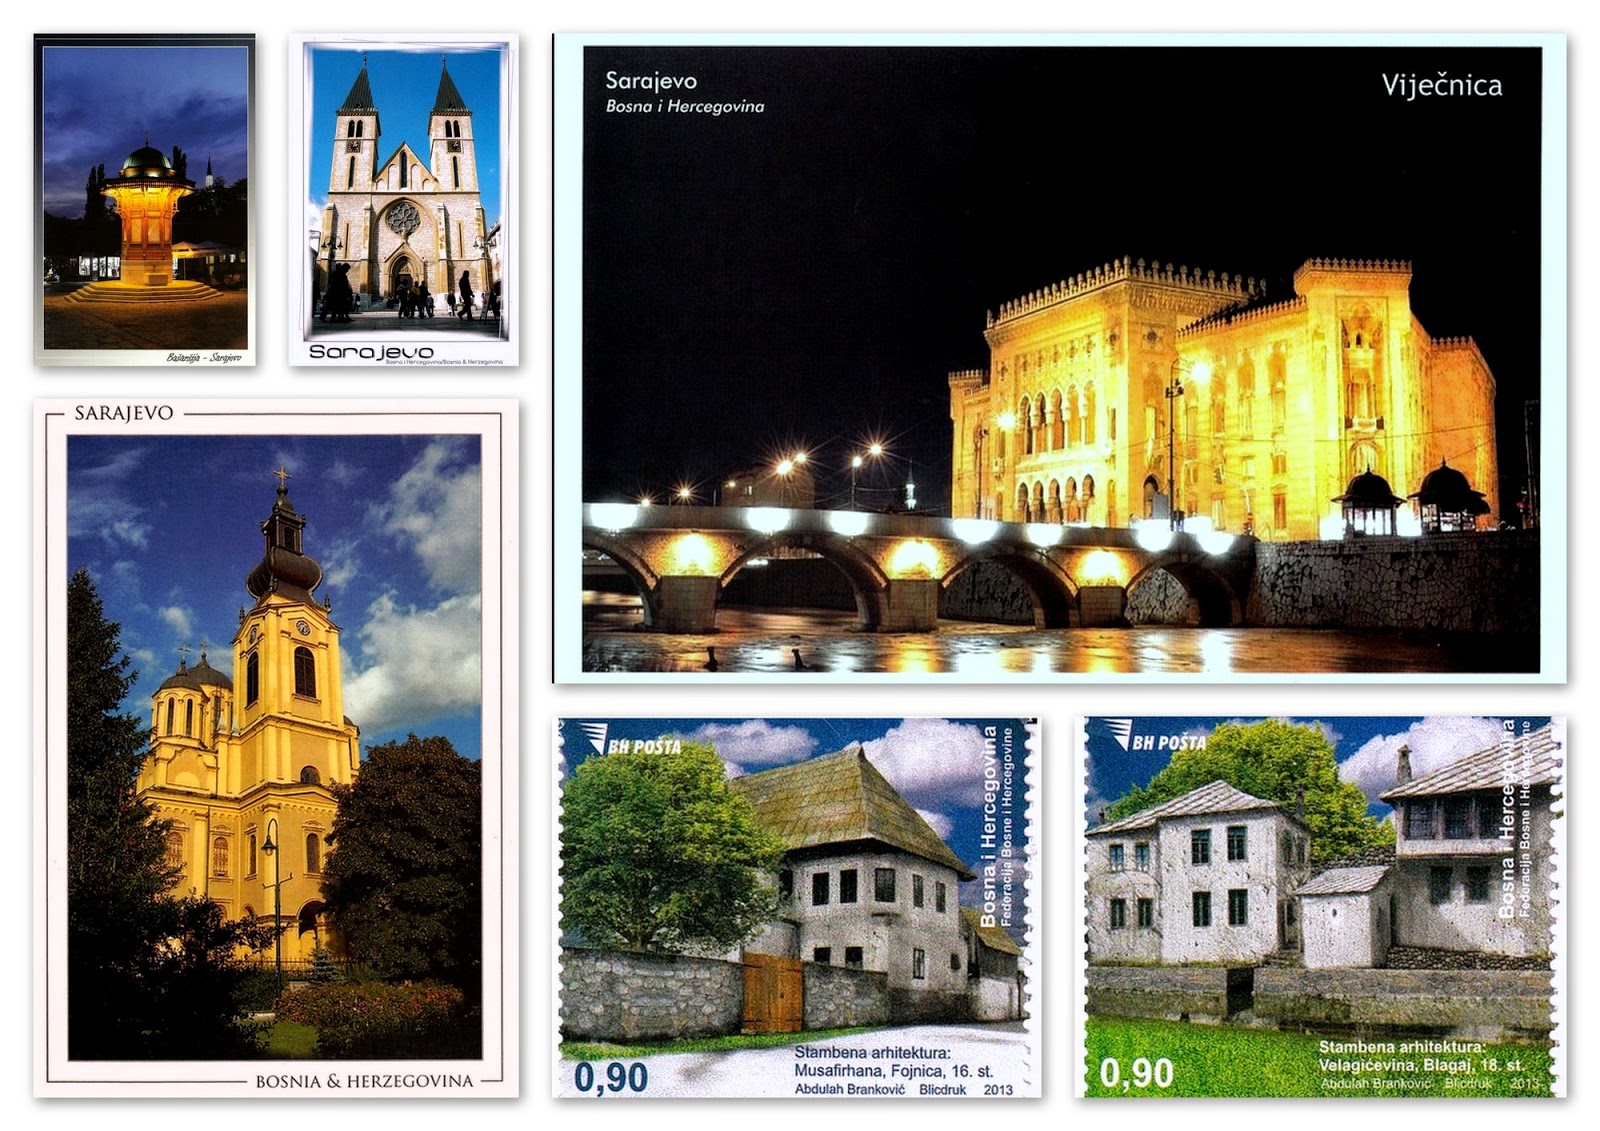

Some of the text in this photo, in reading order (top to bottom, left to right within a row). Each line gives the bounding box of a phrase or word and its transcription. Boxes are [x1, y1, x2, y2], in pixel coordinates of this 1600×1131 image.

[606, 70, 698, 94] Sarajevo
[1381, 70, 1503, 102] Viječnica
[606, 99, 765, 116] Bosna i Hercegovina
[309, 344, 435, 361] Sarajevo
[74, 404, 174, 424] SARAJEVO
[608, 735, 681, 755] BH POŠTA
[1132, 731, 1206, 751] BH POŠTA
[1001, 727, 1014, 807] Hercegovine
[981, 725, 1000, 849] Hercegovina
[1001, 817, 1013, 857] Bosne
[1519, 809, 1531, 849] Bosne
[1001, 861, 1014, 927] Federacija
[1499, 858, 1514, 919] Bosna
[1519, 851, 1532, 918] Federacija
[980, 867, 997, 928] Bosna
[795, 1045, 951, 1060] Stambena arhitektura:
[1319, 1040, 1486, 1054] Stambena arhitektura:
[795, 1063, 994, 1080] Musafirhana, Fojnica, 16. st.
[1100, 1057, 1174, 1093] 0,90
[1319, 1057, 1418, 1075] Velagićevina,
[1507, 1059, 1525, 1072] st.
[256, 1073, 474, 1090] BOSNIA & HERZEGOVINA
[575, 1061, 648, 1097] 0,90
[795, 1083, 1014, 1096] Abdulah Branković Blicdruk 2013
[1321, 1077, 1370, 1089] Abdulah
